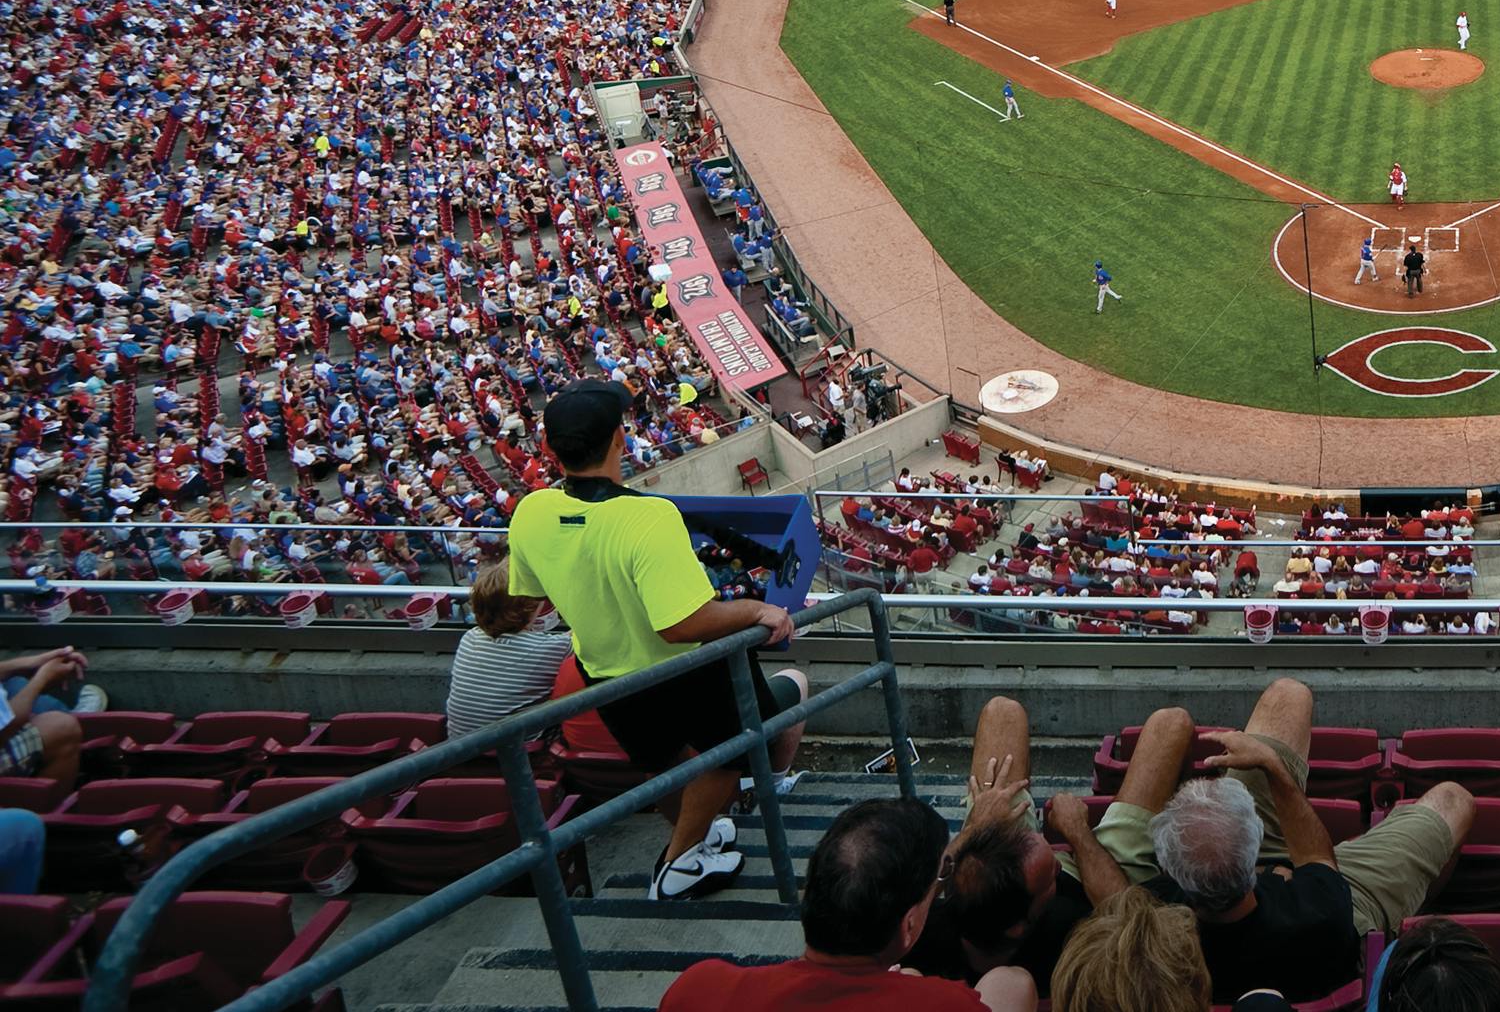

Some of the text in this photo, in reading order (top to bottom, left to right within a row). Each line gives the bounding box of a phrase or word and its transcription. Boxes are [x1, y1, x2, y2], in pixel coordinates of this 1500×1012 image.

[681, 275, 709, 300] 1972
[698, 320, 750, 376] CHAMPIONS
[718, 310, 772, 373] NATIONAL LEAGUE
